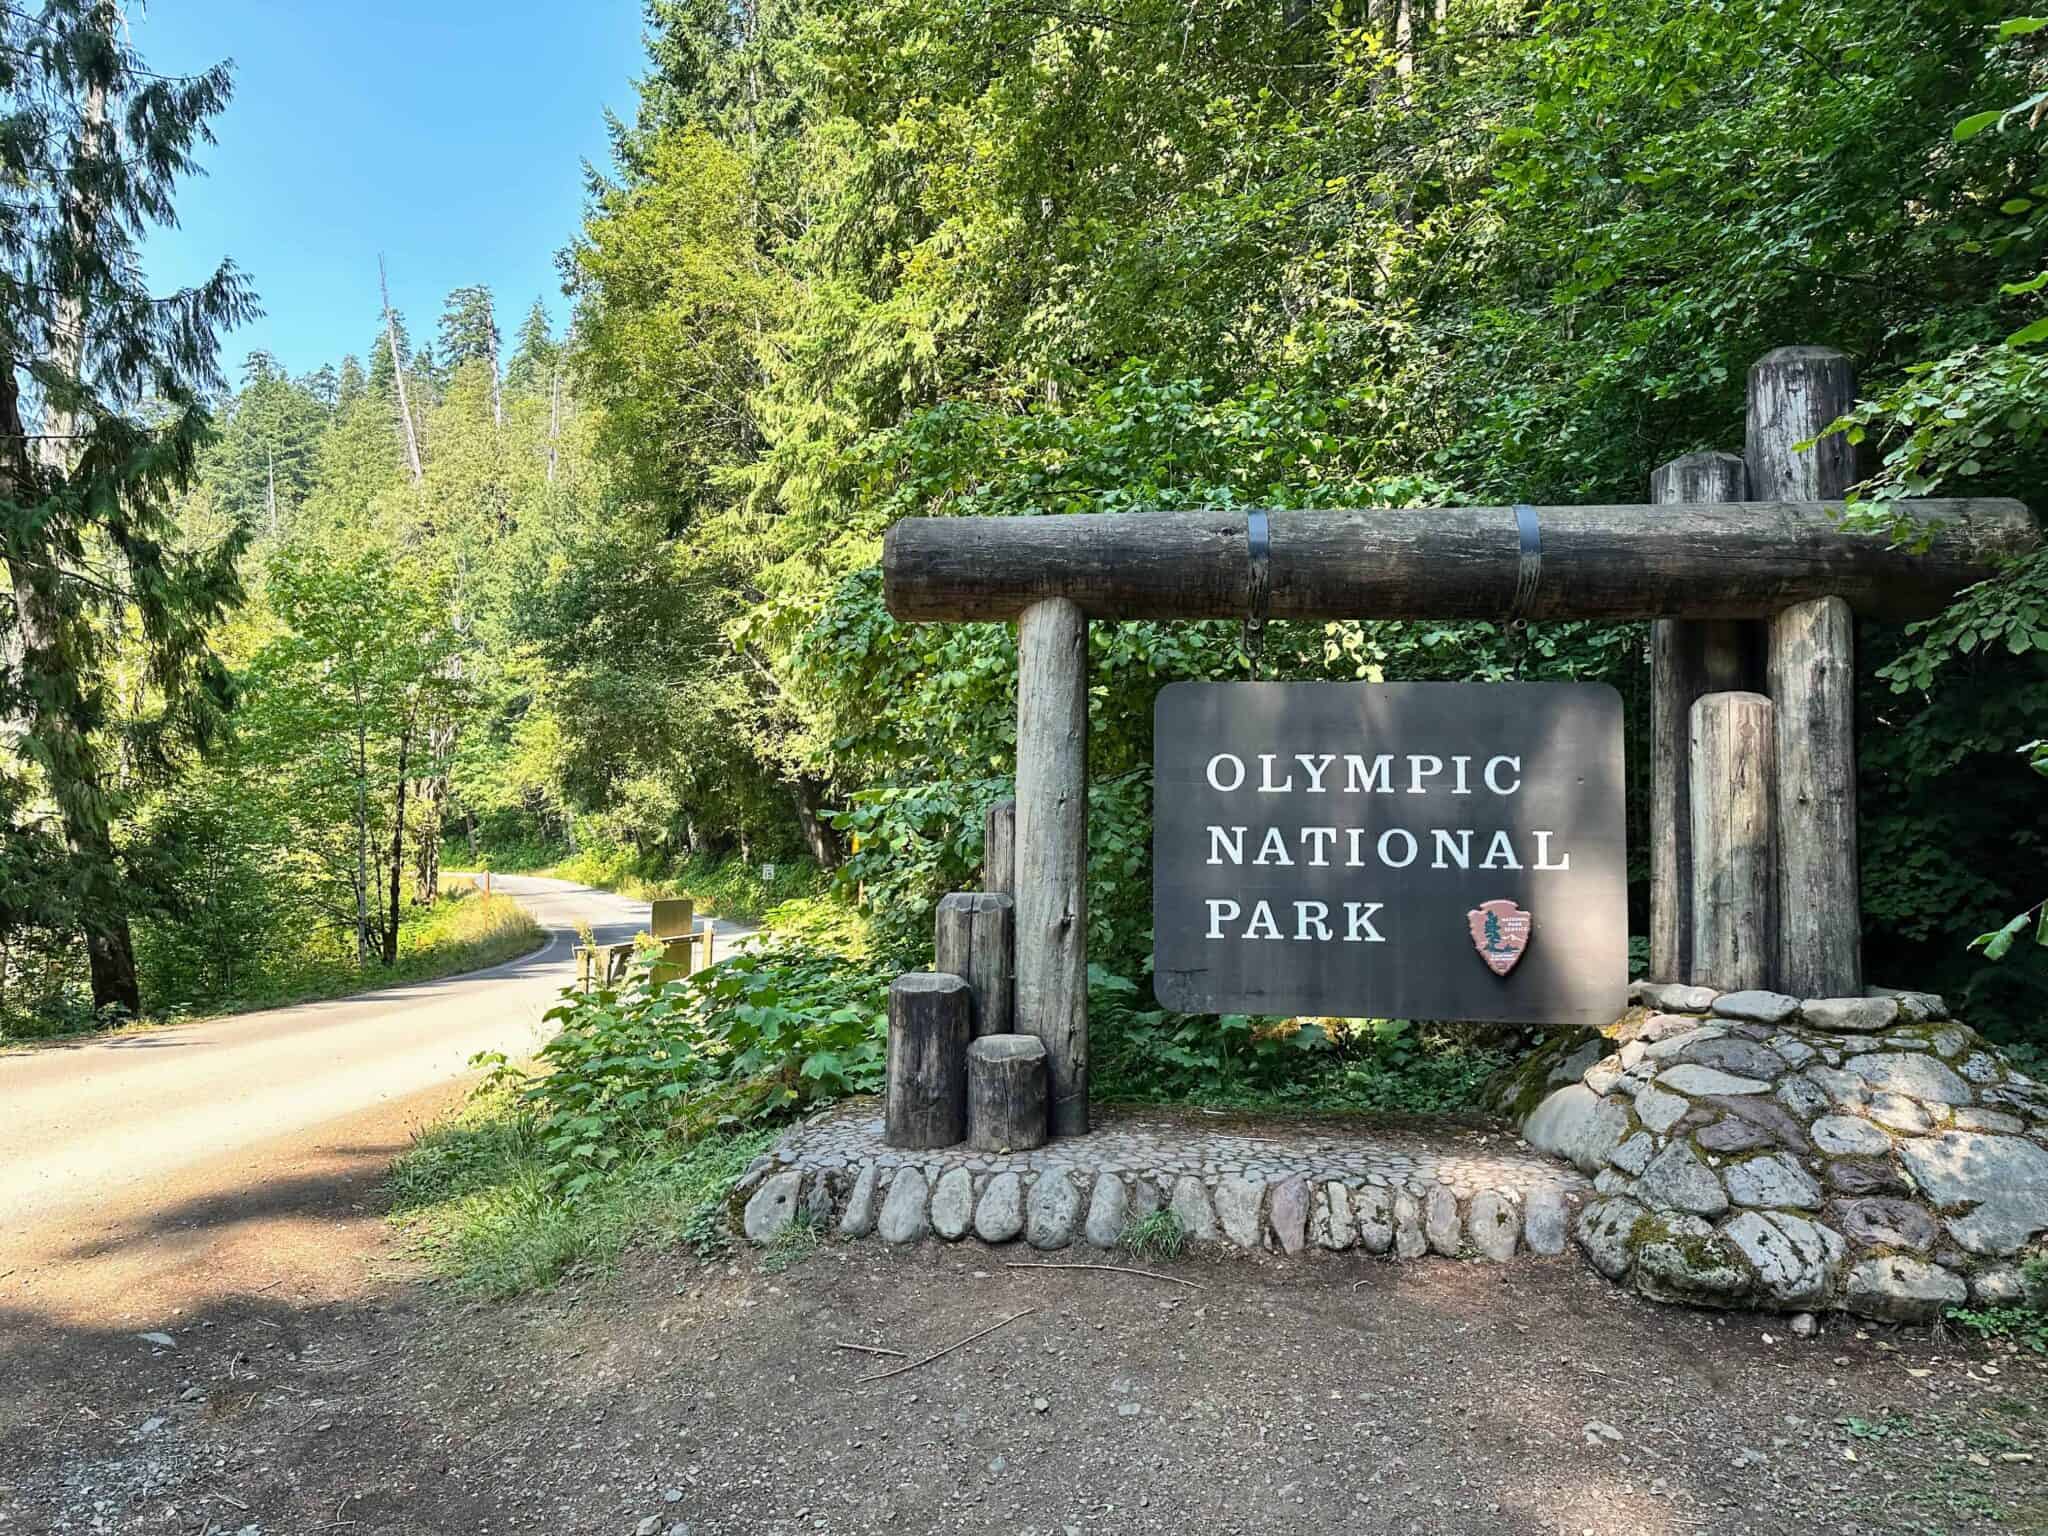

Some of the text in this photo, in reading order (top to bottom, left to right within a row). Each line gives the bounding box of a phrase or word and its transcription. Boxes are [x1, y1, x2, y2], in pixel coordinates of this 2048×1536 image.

[1206, 753, 1521, 795] OLYMPIC
[1206, 826, 1570, 870] NATIONAL
[1205, 900, 1386, 942] PARK
